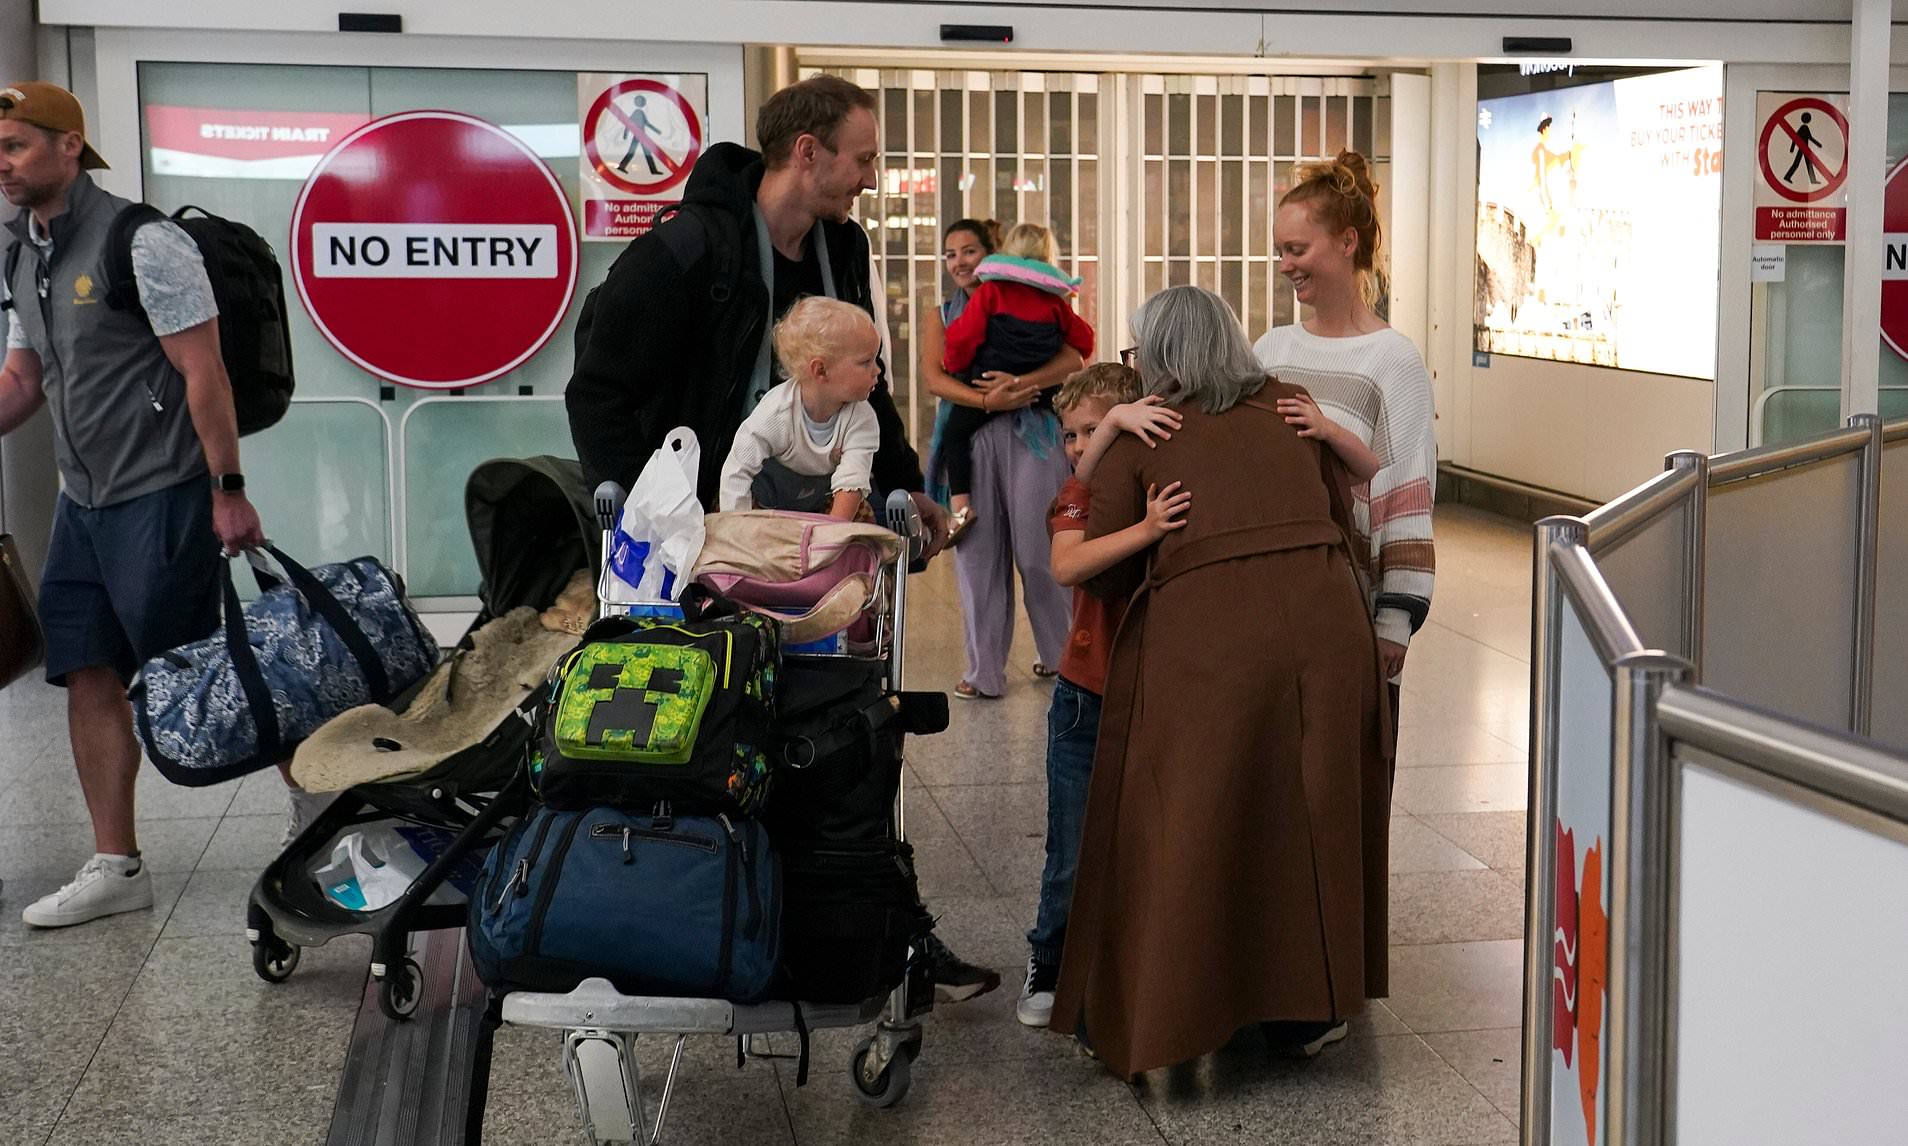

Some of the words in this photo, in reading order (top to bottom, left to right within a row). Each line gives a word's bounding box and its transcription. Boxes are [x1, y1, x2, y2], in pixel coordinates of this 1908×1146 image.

[1659, 102, 1684, 120] THIS
[1687, 98, 1713, 117] WAY
[1716, 96, 1723, 115] T
[1630, 129, 1653, 148] BUY
[1655, 126, 1686, 145] YOUR
[1689, 122, 1722, 142] TICKE
[1659, 150, 1690, 169] WITH
[604, 202, 621, 213] No
[622, 202, 663, 213] admitt
[1771, 209, 1784, 219] No
[1786, 209, 1837, 219] admittance
[1779, 220, 1828, 229] Authorised
[1770, 231, 1815, 240] personnel
[1816, 231, 1836, 240] only
[330, 235, 391, 266] NO
[406, 236, 542, 266] ENTRY
[1886, 243, 1908, 271] N
